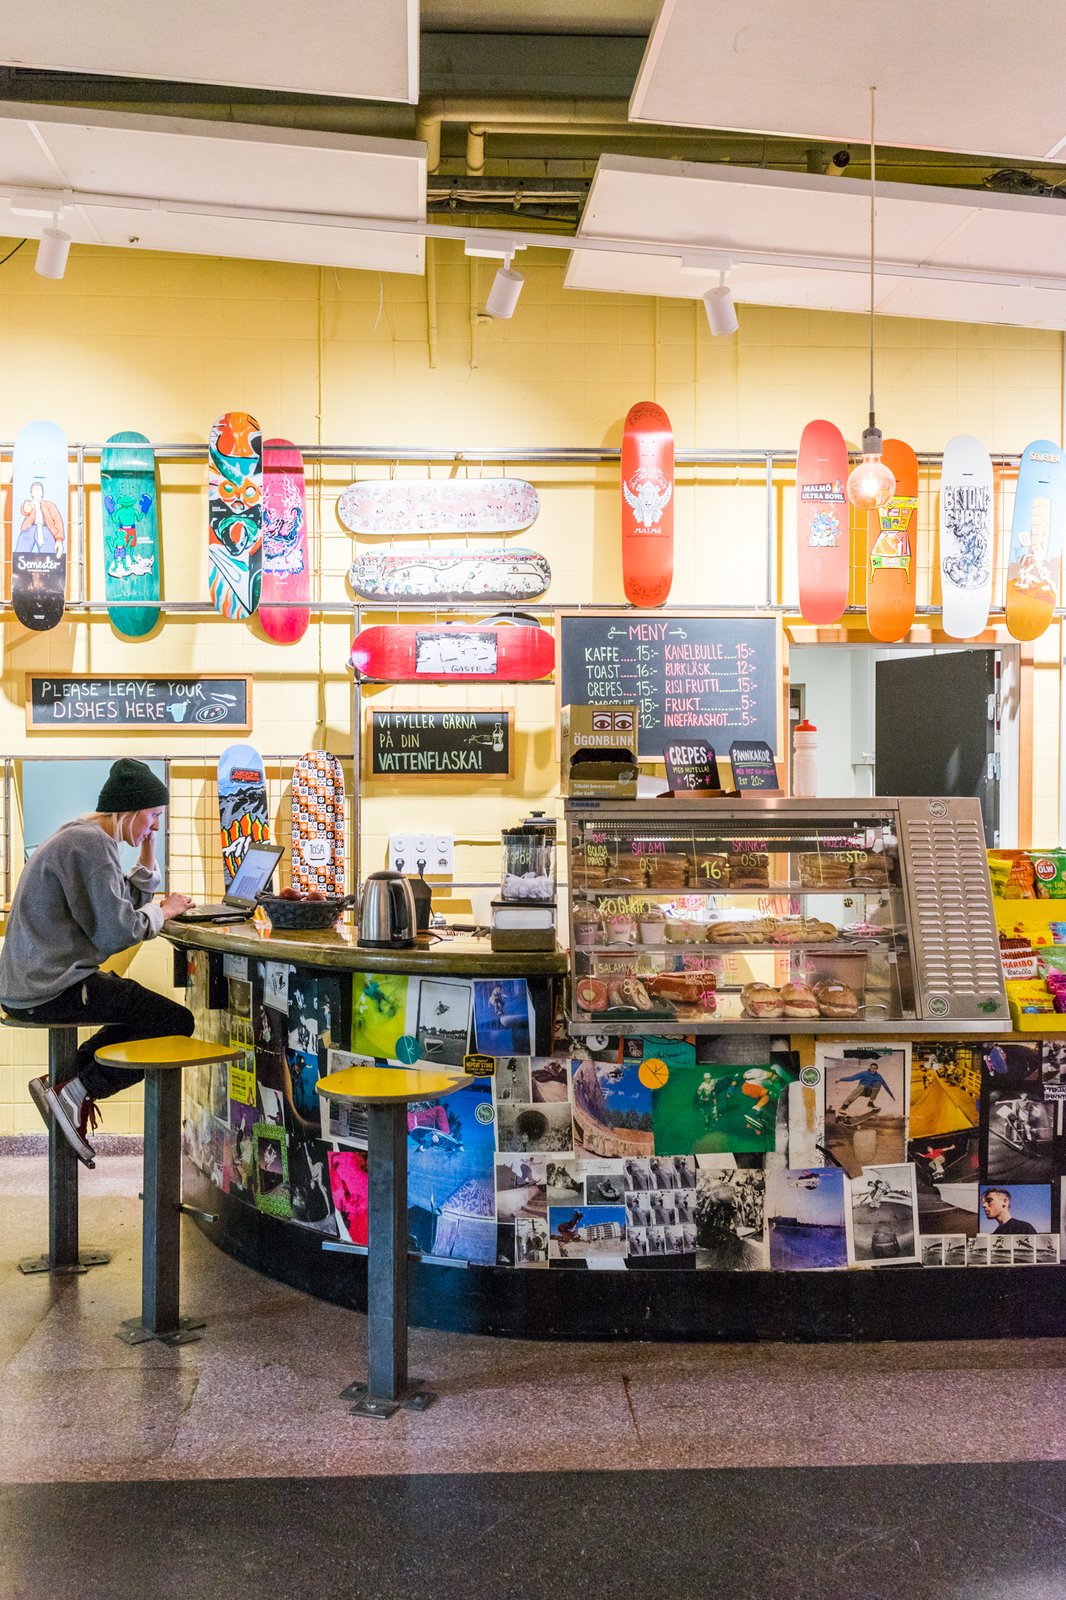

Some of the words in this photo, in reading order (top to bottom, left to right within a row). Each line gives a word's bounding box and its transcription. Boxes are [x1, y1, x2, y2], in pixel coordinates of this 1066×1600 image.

[17, 555, 61, 570] Semester
[629, 624, 668, 641] MENY
[585, 647, 619, 662] KAFFE
[636, 645, 659, 661] 15:-
[664, 643, 723, 660] KANELBULLE
[735, 643, 756, 659] 15:-
[586, 665, 620, 679] TOAST
[636, 664, 658, 678] 16:-
[665, 661, 711, 676] BURKLÄSK
[736, 660, 756, 675] 12:-
[41, 681, 101, 700] PLEASE
[108, 681, 156, 699] LEAVE
[168, 682, 206, 700] YOUR
[587, 682, 623, 697] CREPES
[636, 681, 658, 696] 15:-
[665, 679, 683, 694] RISI
[685, 678, 719, 694] FRUTTI
[737, 677, 758, 693] 15:-
[53, 701, 117, 719] DISHES
[126, 701, 165, 720] HERE
[665, 698, 701, 712] FRUKT
[378, 715, 390, 728] VI
[395, 714, 435, 729] FYLLER
[442, 713, 477, 729] GÄRNA
[664, 712, 728, 727] INGEFÄRASHOT
[380, 730, 394, 748] PÅ
[401, 733, 420, 748] DIN
[574, 733, 634, 746] ÖGONBLINK
[378, 750, 482, 771] VATTENFLASKA!
[669, 745, 707, 765] CREPES
[732, 749, 771, 762] PANNKAKOR
[673, 766, 684, 774] MED
[683, 774, 702, 788] 15:-
[587, 845, 608, 857] GOUDA
[631, 842, 666, 856] SALAMI
[732, 841, 768, 853] SKINKA
[640, 857, 659, 872] OST
[741, 854, 762, 867] OST
[598, 896, 652, 915] YOGHURT
[1002, 959, 1033, 968] HARIBO
